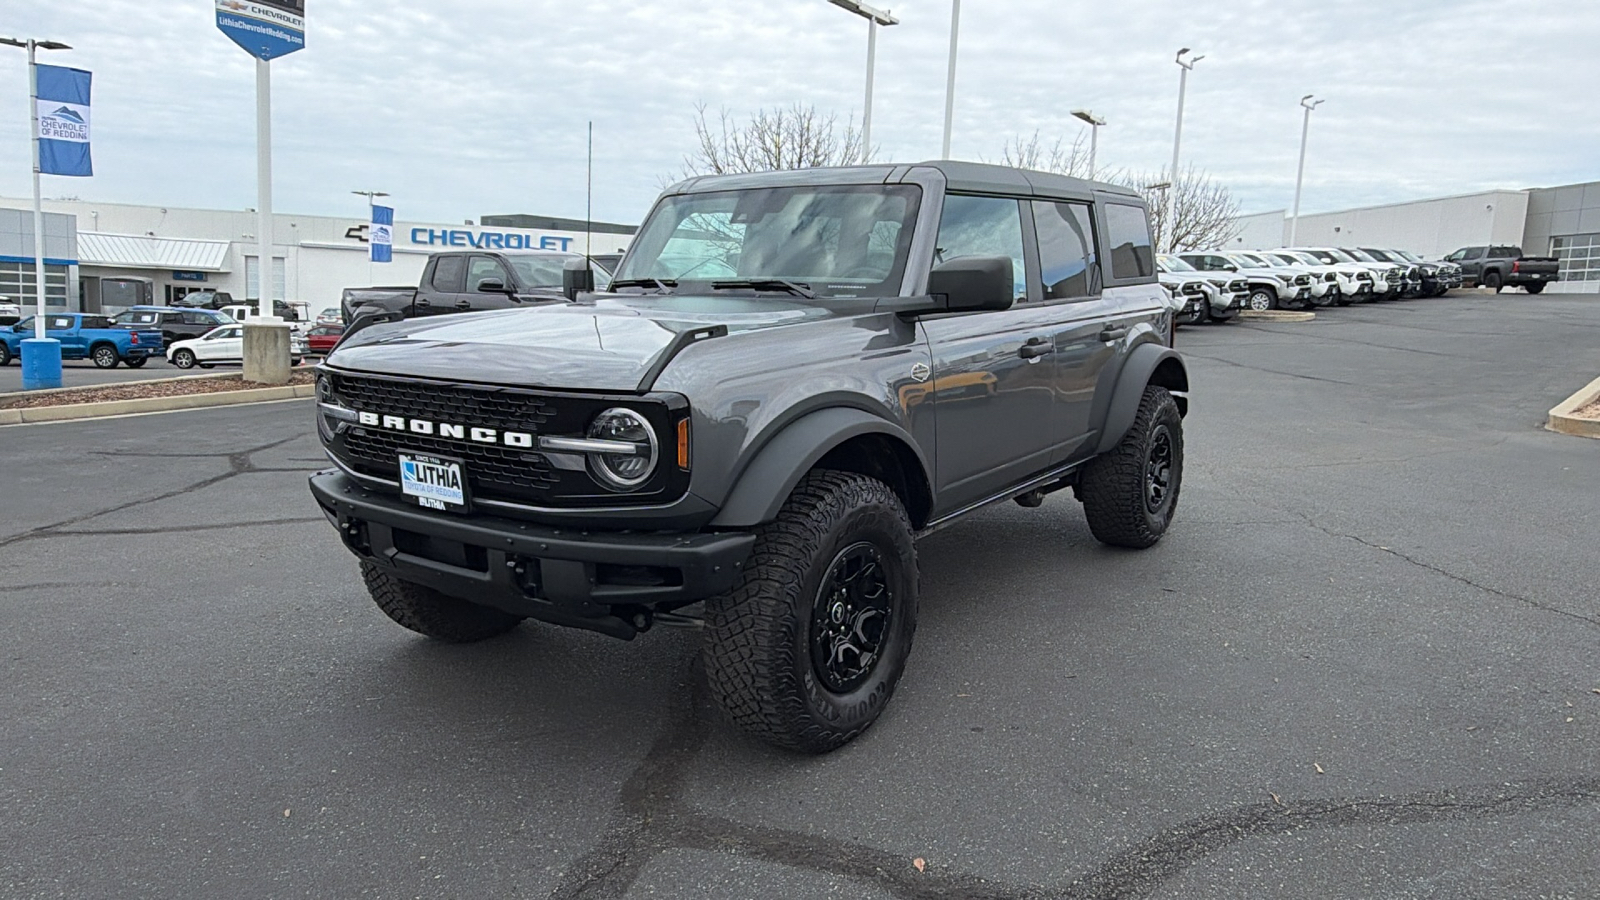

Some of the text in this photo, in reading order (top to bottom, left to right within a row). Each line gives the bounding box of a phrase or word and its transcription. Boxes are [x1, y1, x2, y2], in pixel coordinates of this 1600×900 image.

[251, 6, 302, 26] CHEVROLET
[219, 16, 303, 44] LithiaChevroletRedding.com
[41, 120, 87, 132] CHEVROLET
[411, 227, 574, 252] CHEVROLET
[359, 411, 533, 448] BRONCO
[415, 463, 461, 490] LITHIA
[404, 481, 426, 492] TOYOTA
[435, 487, 462, 499] REDDING
[425, 497, 446, 510] LITHIA
